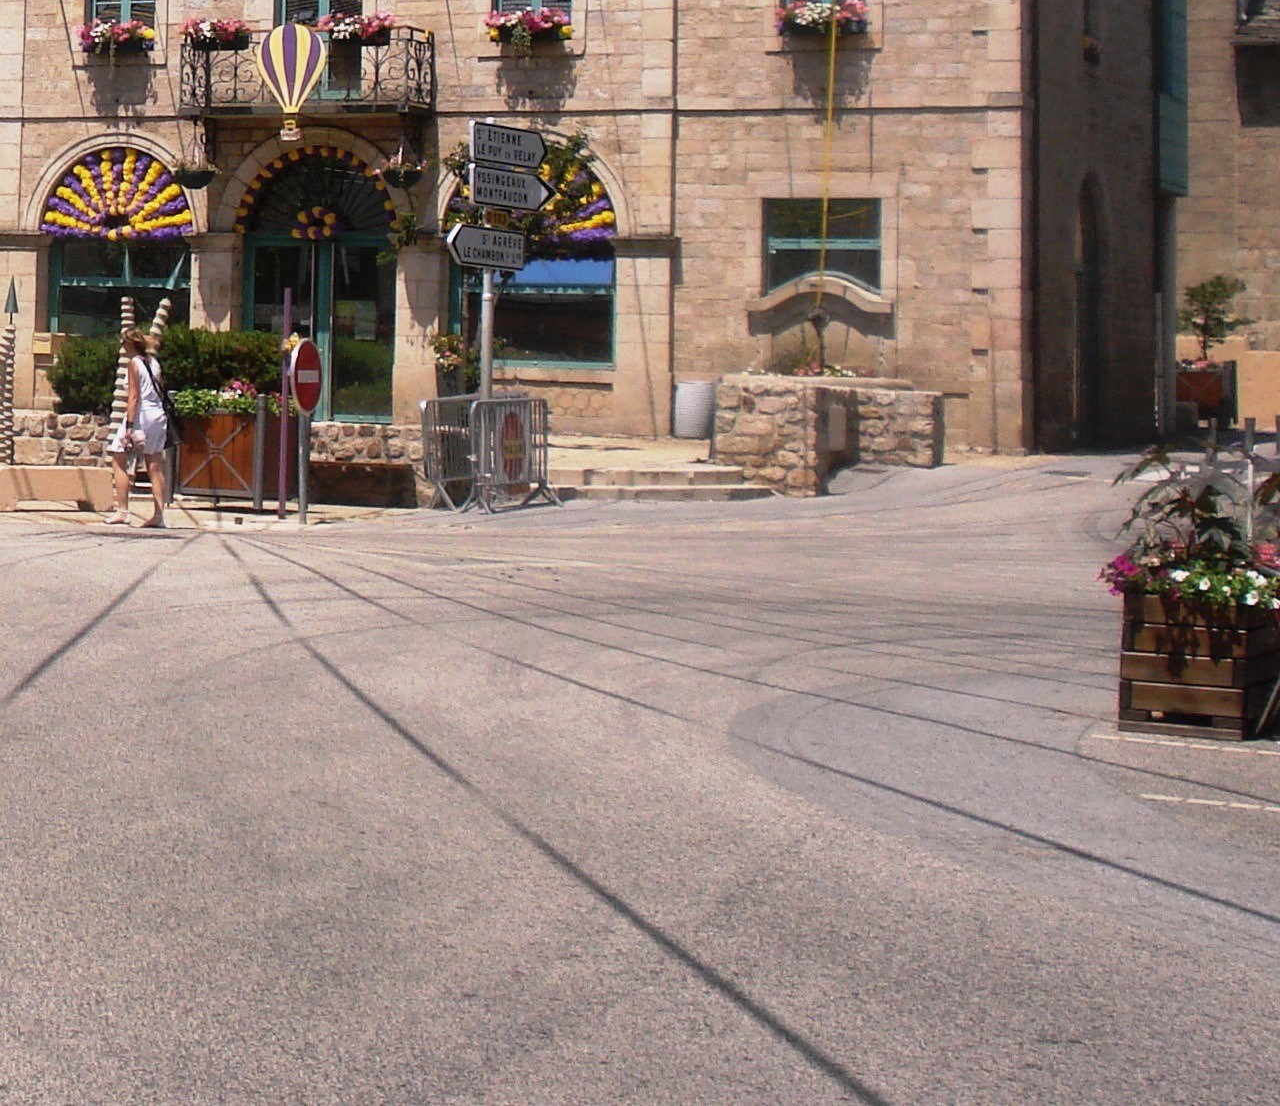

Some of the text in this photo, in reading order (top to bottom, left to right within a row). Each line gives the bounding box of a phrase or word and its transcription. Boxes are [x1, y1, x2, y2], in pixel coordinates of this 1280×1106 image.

[477, 143, 486, 155] LE
[488, 145, 502, 157] PUY
[514, 149, 537, 162] VELAY
[477, 186, 528, 204] MONTFAUCON
[463, 246, 471, 258] LE
[472, 247, 505, 262] CHAMBON
